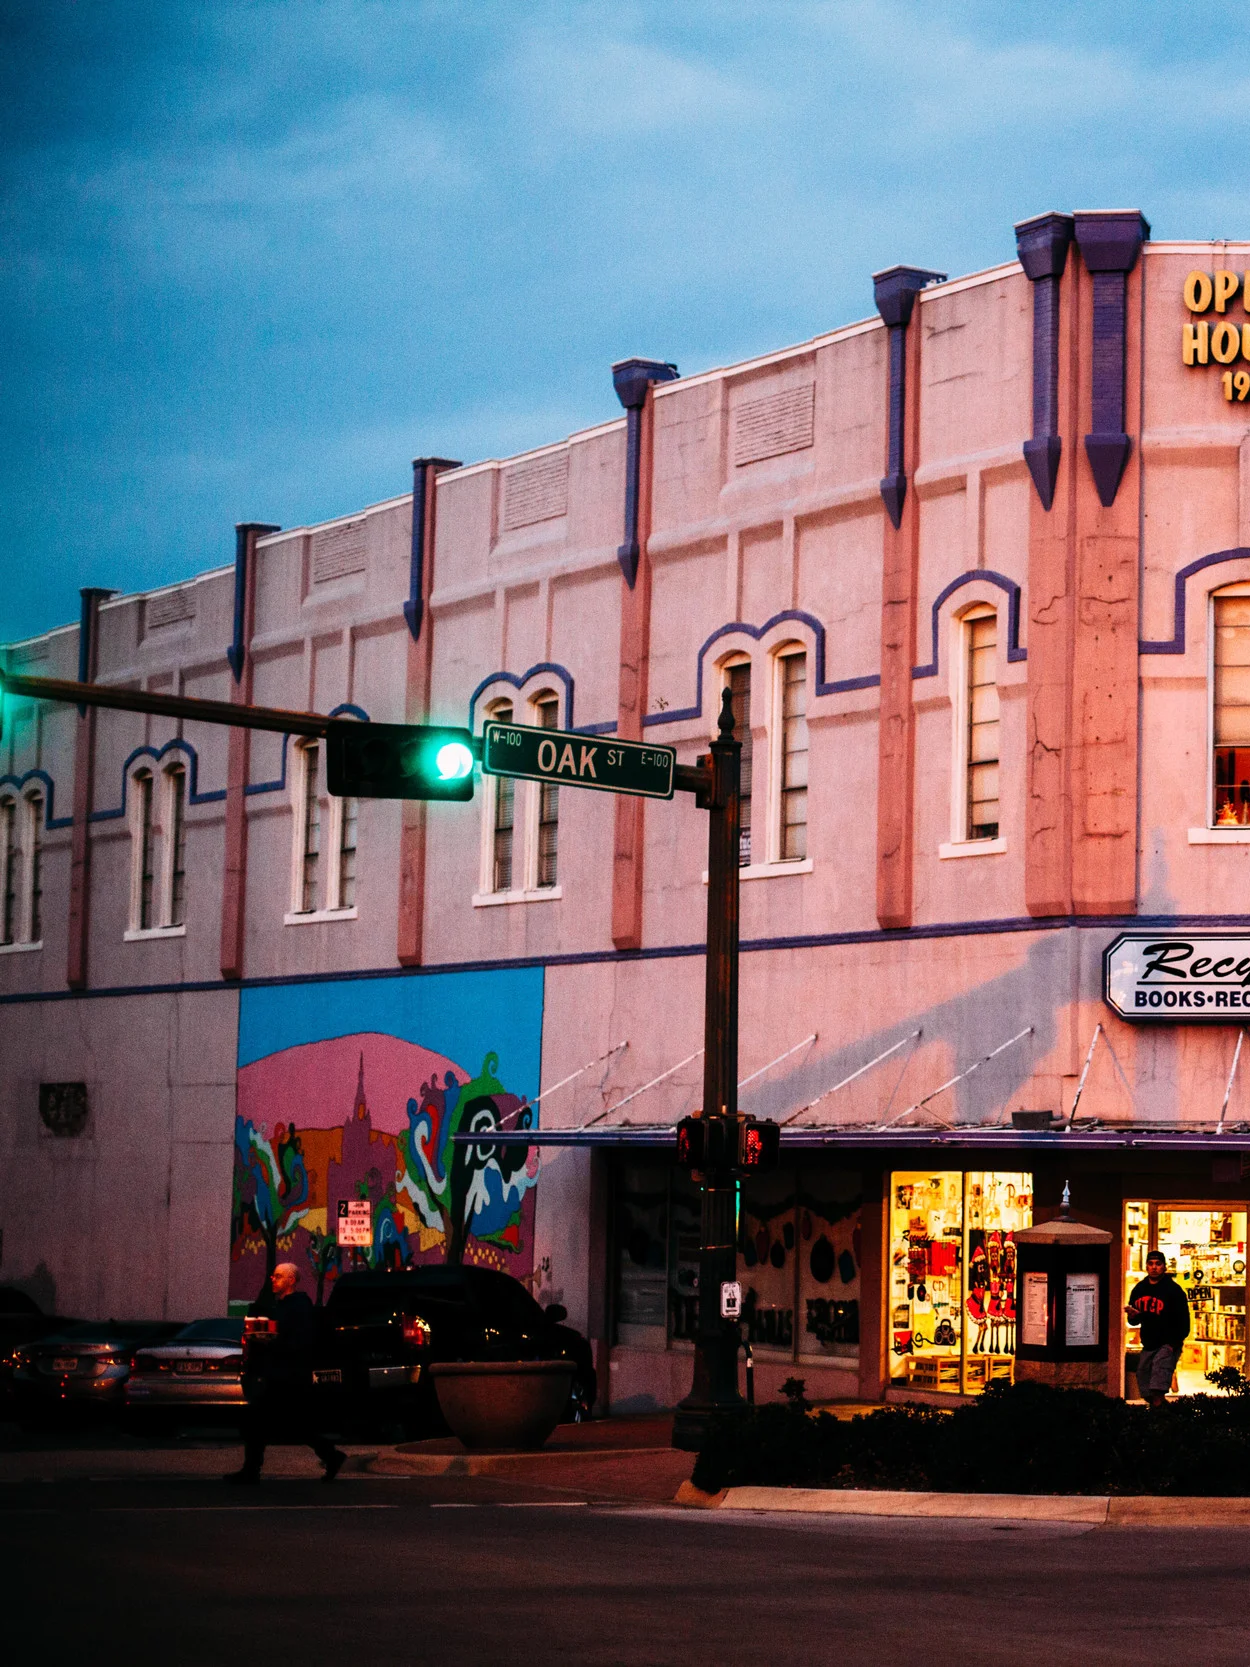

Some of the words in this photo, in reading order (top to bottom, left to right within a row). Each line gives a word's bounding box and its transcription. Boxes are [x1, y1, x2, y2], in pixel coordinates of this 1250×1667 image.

[492, 730, 522, 747] W-100
[537, 739, 598, 779] OAK
[607, 749, 625, 767] ST
[641, 751, 669, 768] E-100
[339, 1203, 346, 1215] 2
[1187, 1287, 1211, 1300] OPEN
